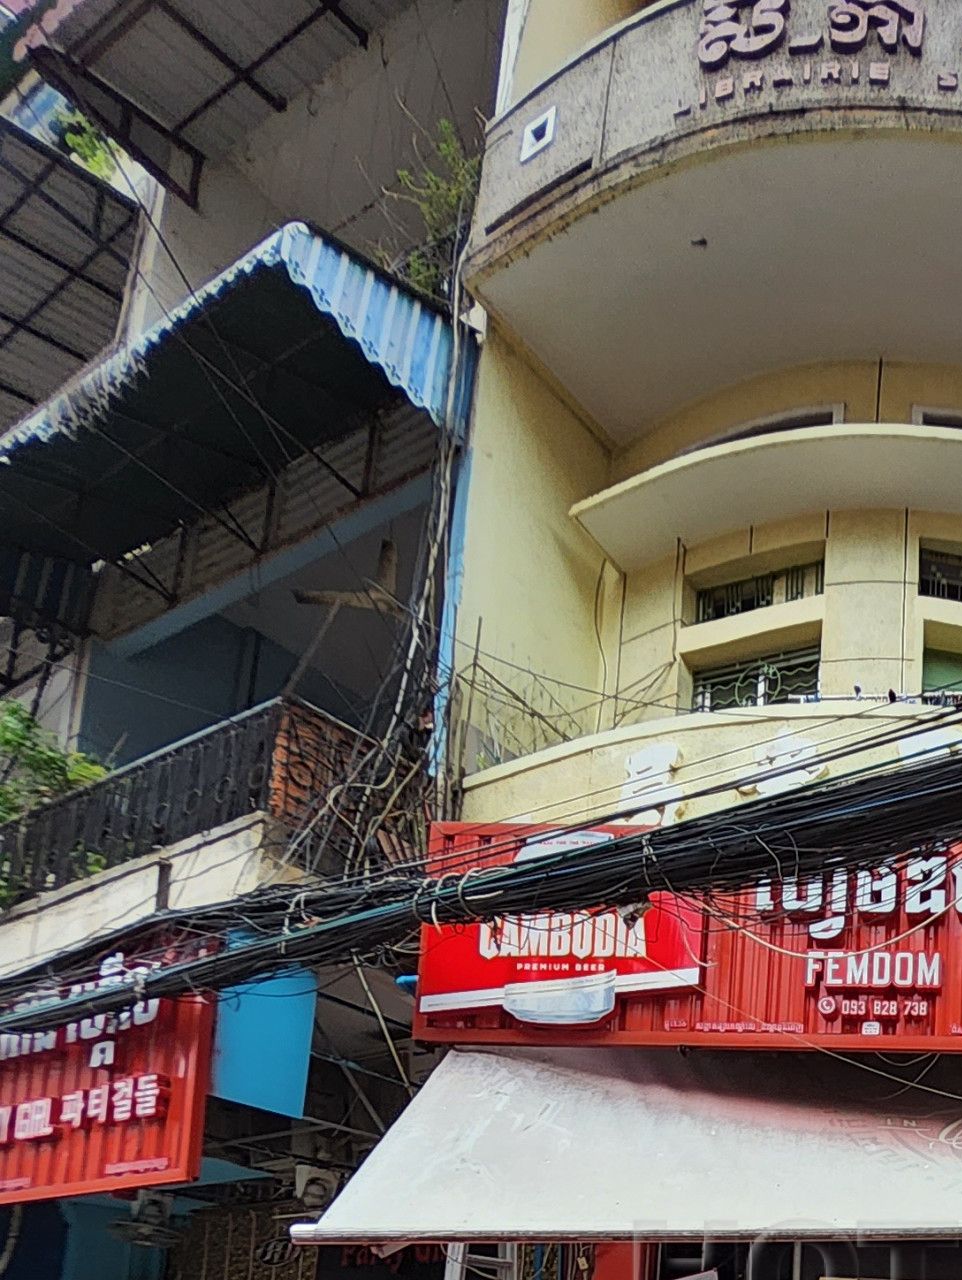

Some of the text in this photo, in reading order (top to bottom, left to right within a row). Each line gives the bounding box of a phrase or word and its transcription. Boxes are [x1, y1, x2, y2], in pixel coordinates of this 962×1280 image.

[479, 911, 647, 960] CAMBODIA
[516, 962, 605, 972] PREMIUM BEER
[806, 951, 941, 986] FEMDOM
[842, 1000, 929, 1016] 093 828 738
